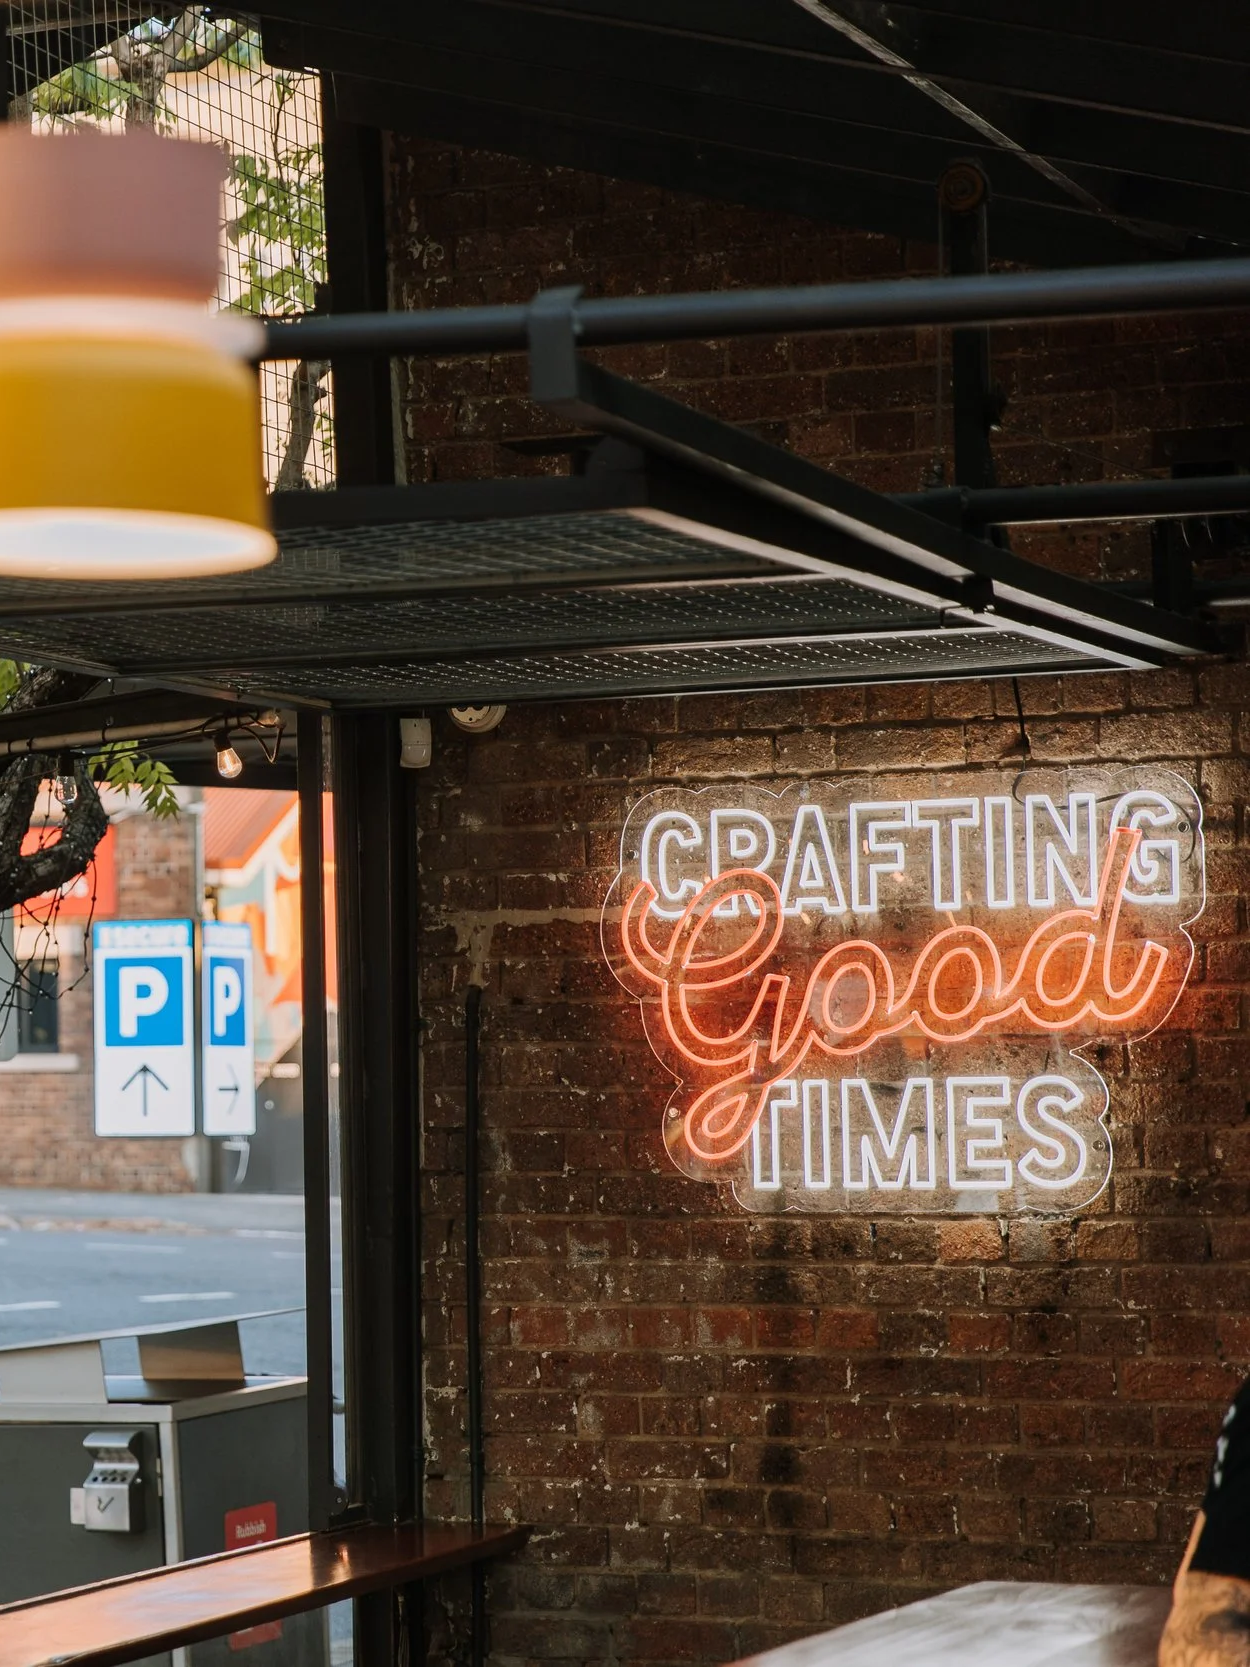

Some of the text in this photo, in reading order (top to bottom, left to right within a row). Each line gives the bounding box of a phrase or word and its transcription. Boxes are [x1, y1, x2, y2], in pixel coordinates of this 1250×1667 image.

[641, 790, 1180, 918] CRAFTING
[118, 966, 169, 1038] P
[213, 966, 241, 1037] P
[621, 828, 1168, 1160] Good
[753, 1076, 1086, 1190] TIMES
